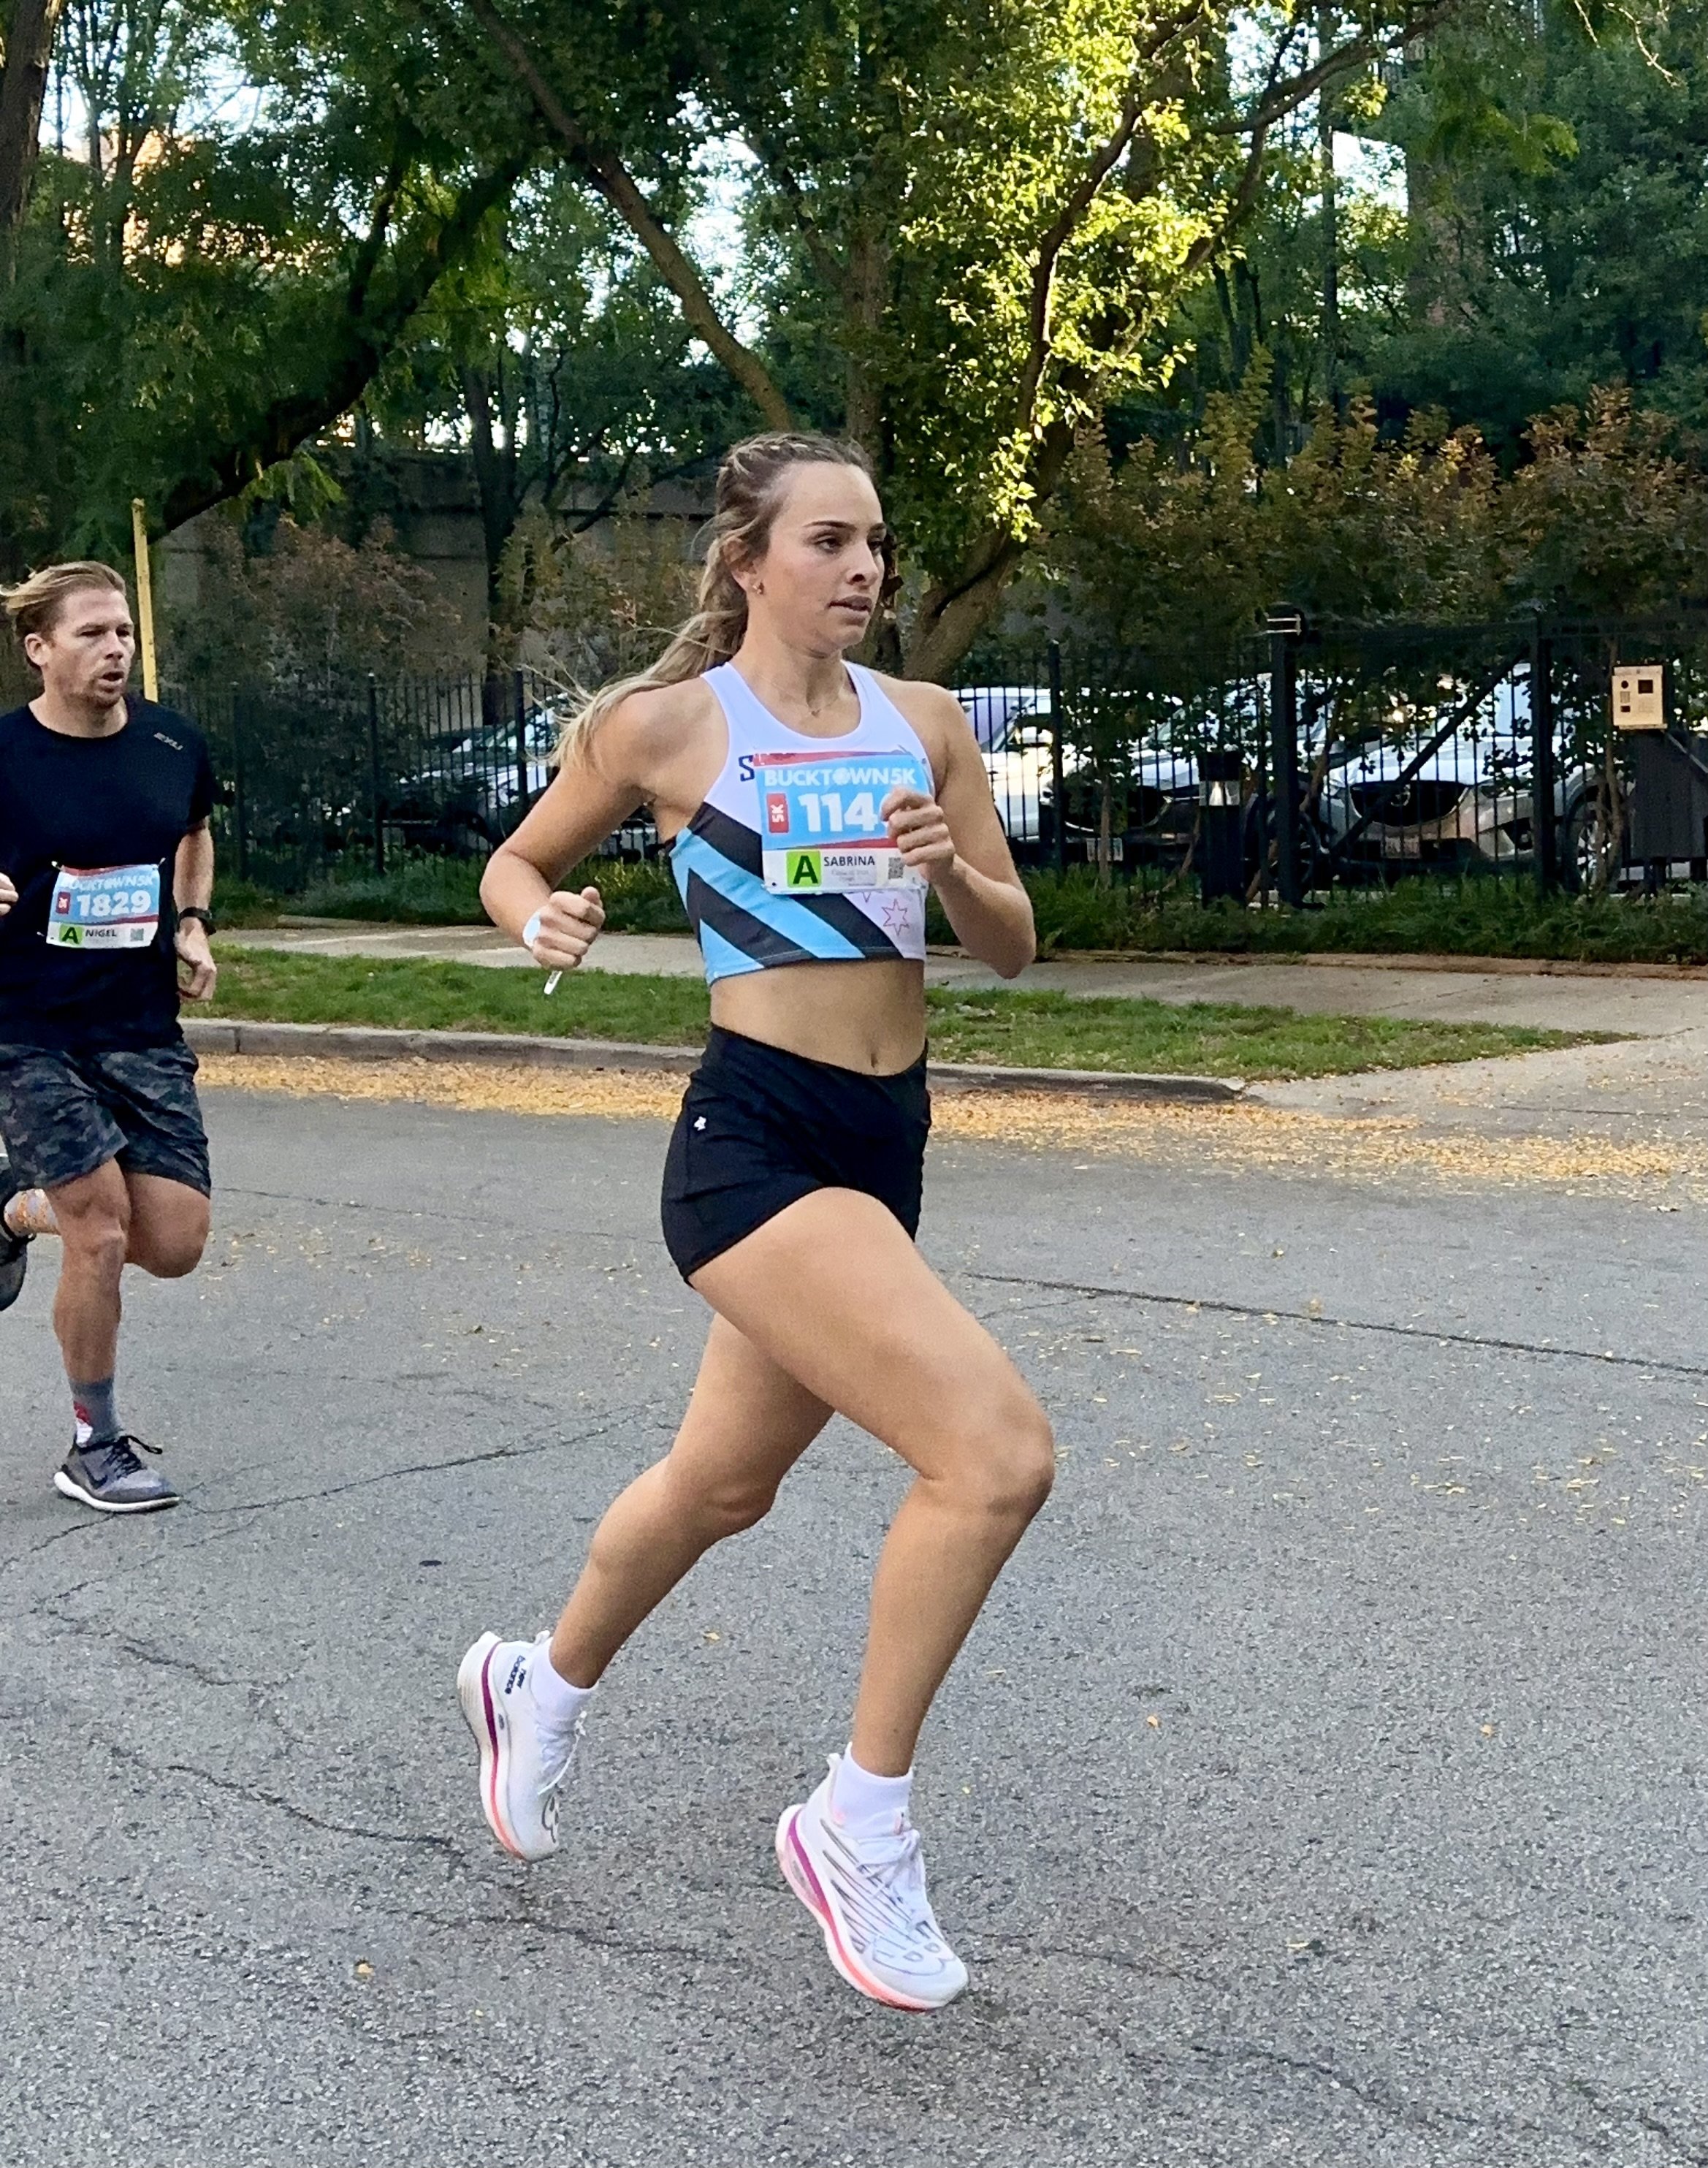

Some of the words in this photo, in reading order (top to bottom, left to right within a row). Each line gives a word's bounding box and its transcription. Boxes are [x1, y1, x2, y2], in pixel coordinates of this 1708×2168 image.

[771, 804, 785, 823] 5K
[798, 792, 889, 832] 114
[793, 855, 818, 885] A
[823, 856, 875, 867] SABRINA
[63, 875, 153, 891] UCKTOWN5K
[77, 890, 151, 917] 1829
[61, 927, 80, 945] A
[85, 929, 117, 937] NIGEL
[504, 1655, 526, 1695] balance
